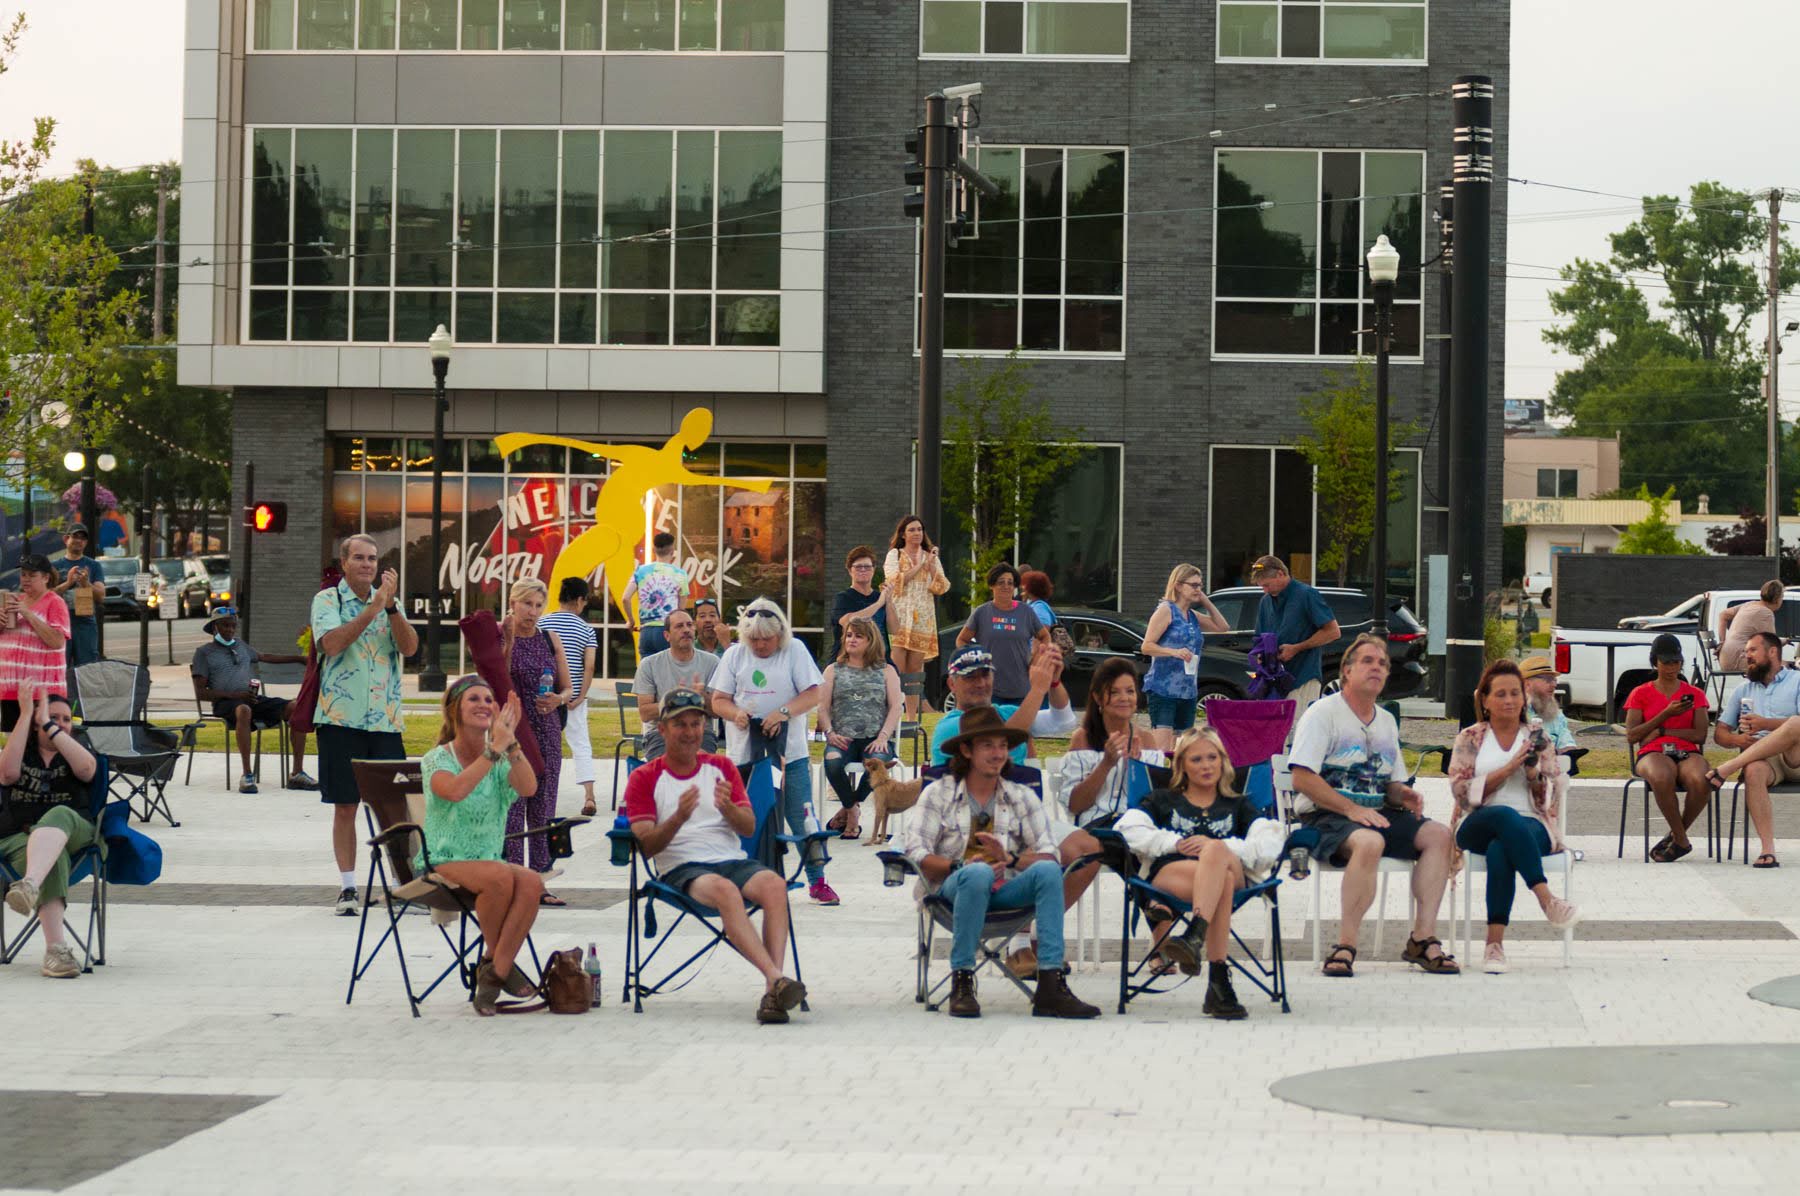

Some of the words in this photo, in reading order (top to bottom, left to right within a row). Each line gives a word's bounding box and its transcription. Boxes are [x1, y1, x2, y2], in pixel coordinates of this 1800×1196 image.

[497, 482, 679, 533] WELCE
[439, 543, 543, 590] NORTH
[672, 547, 744, 587] OCK
